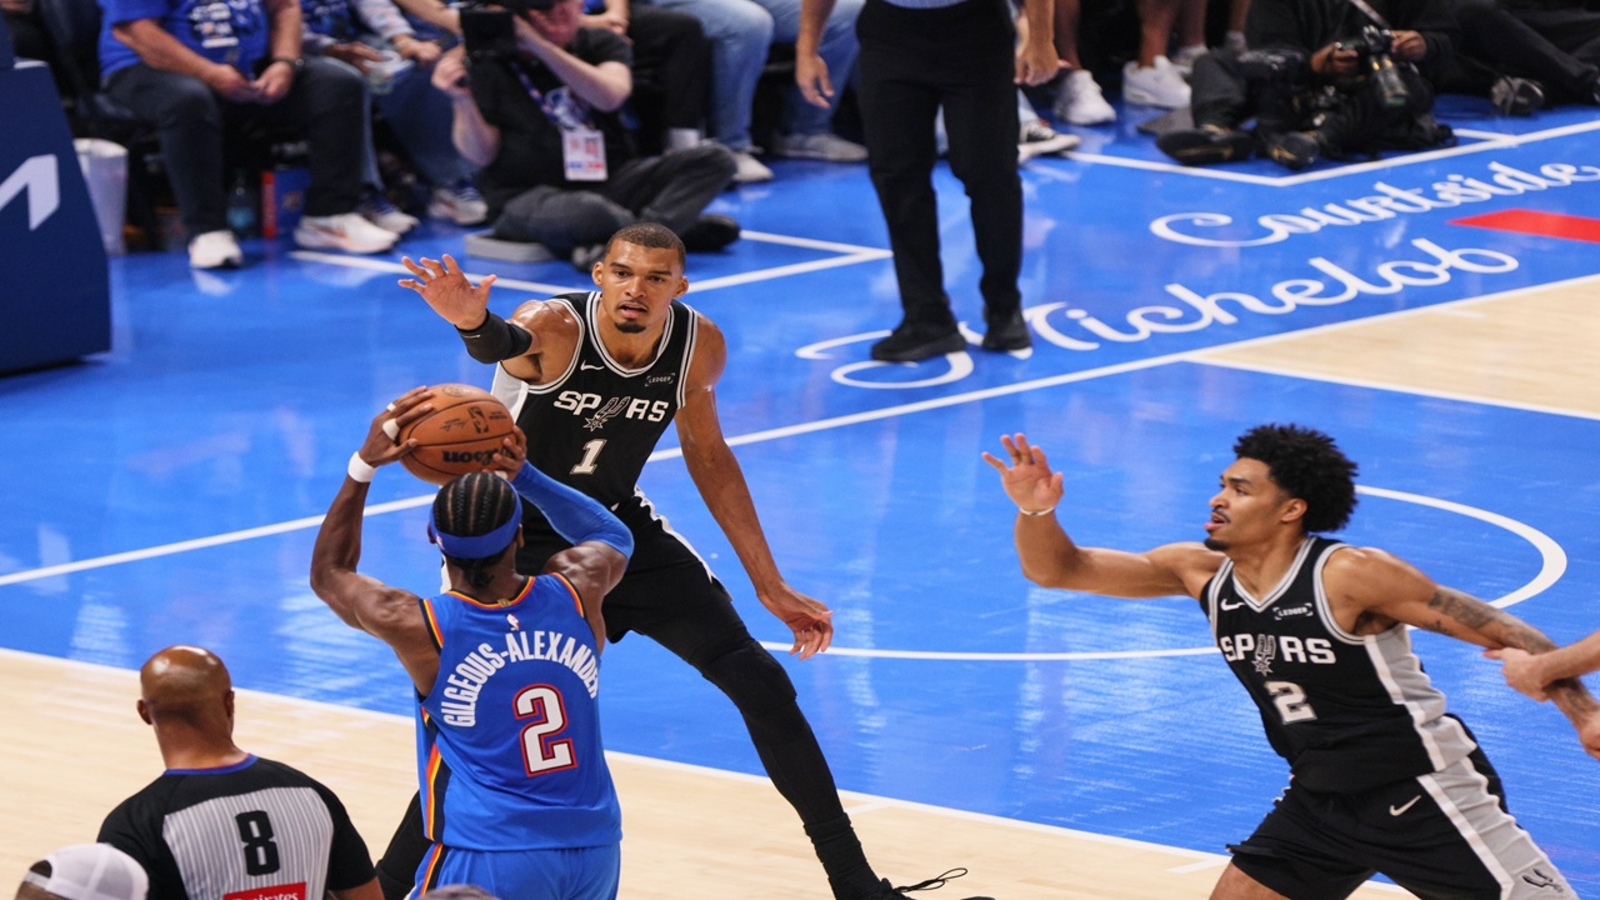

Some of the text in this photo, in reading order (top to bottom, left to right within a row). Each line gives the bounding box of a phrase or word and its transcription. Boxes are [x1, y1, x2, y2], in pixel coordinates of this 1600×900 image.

[1149, 161, 1600, 248] Courtside
[553, 390, 669, 432] SPURS
[570, 439, 607, 475] 1
[1220, 633, 1336, 677] SPURS
[1264, 681, 1318, 725] 2
[512, 683, 578, 778] 2
[235, 809, 281, 877] 8
